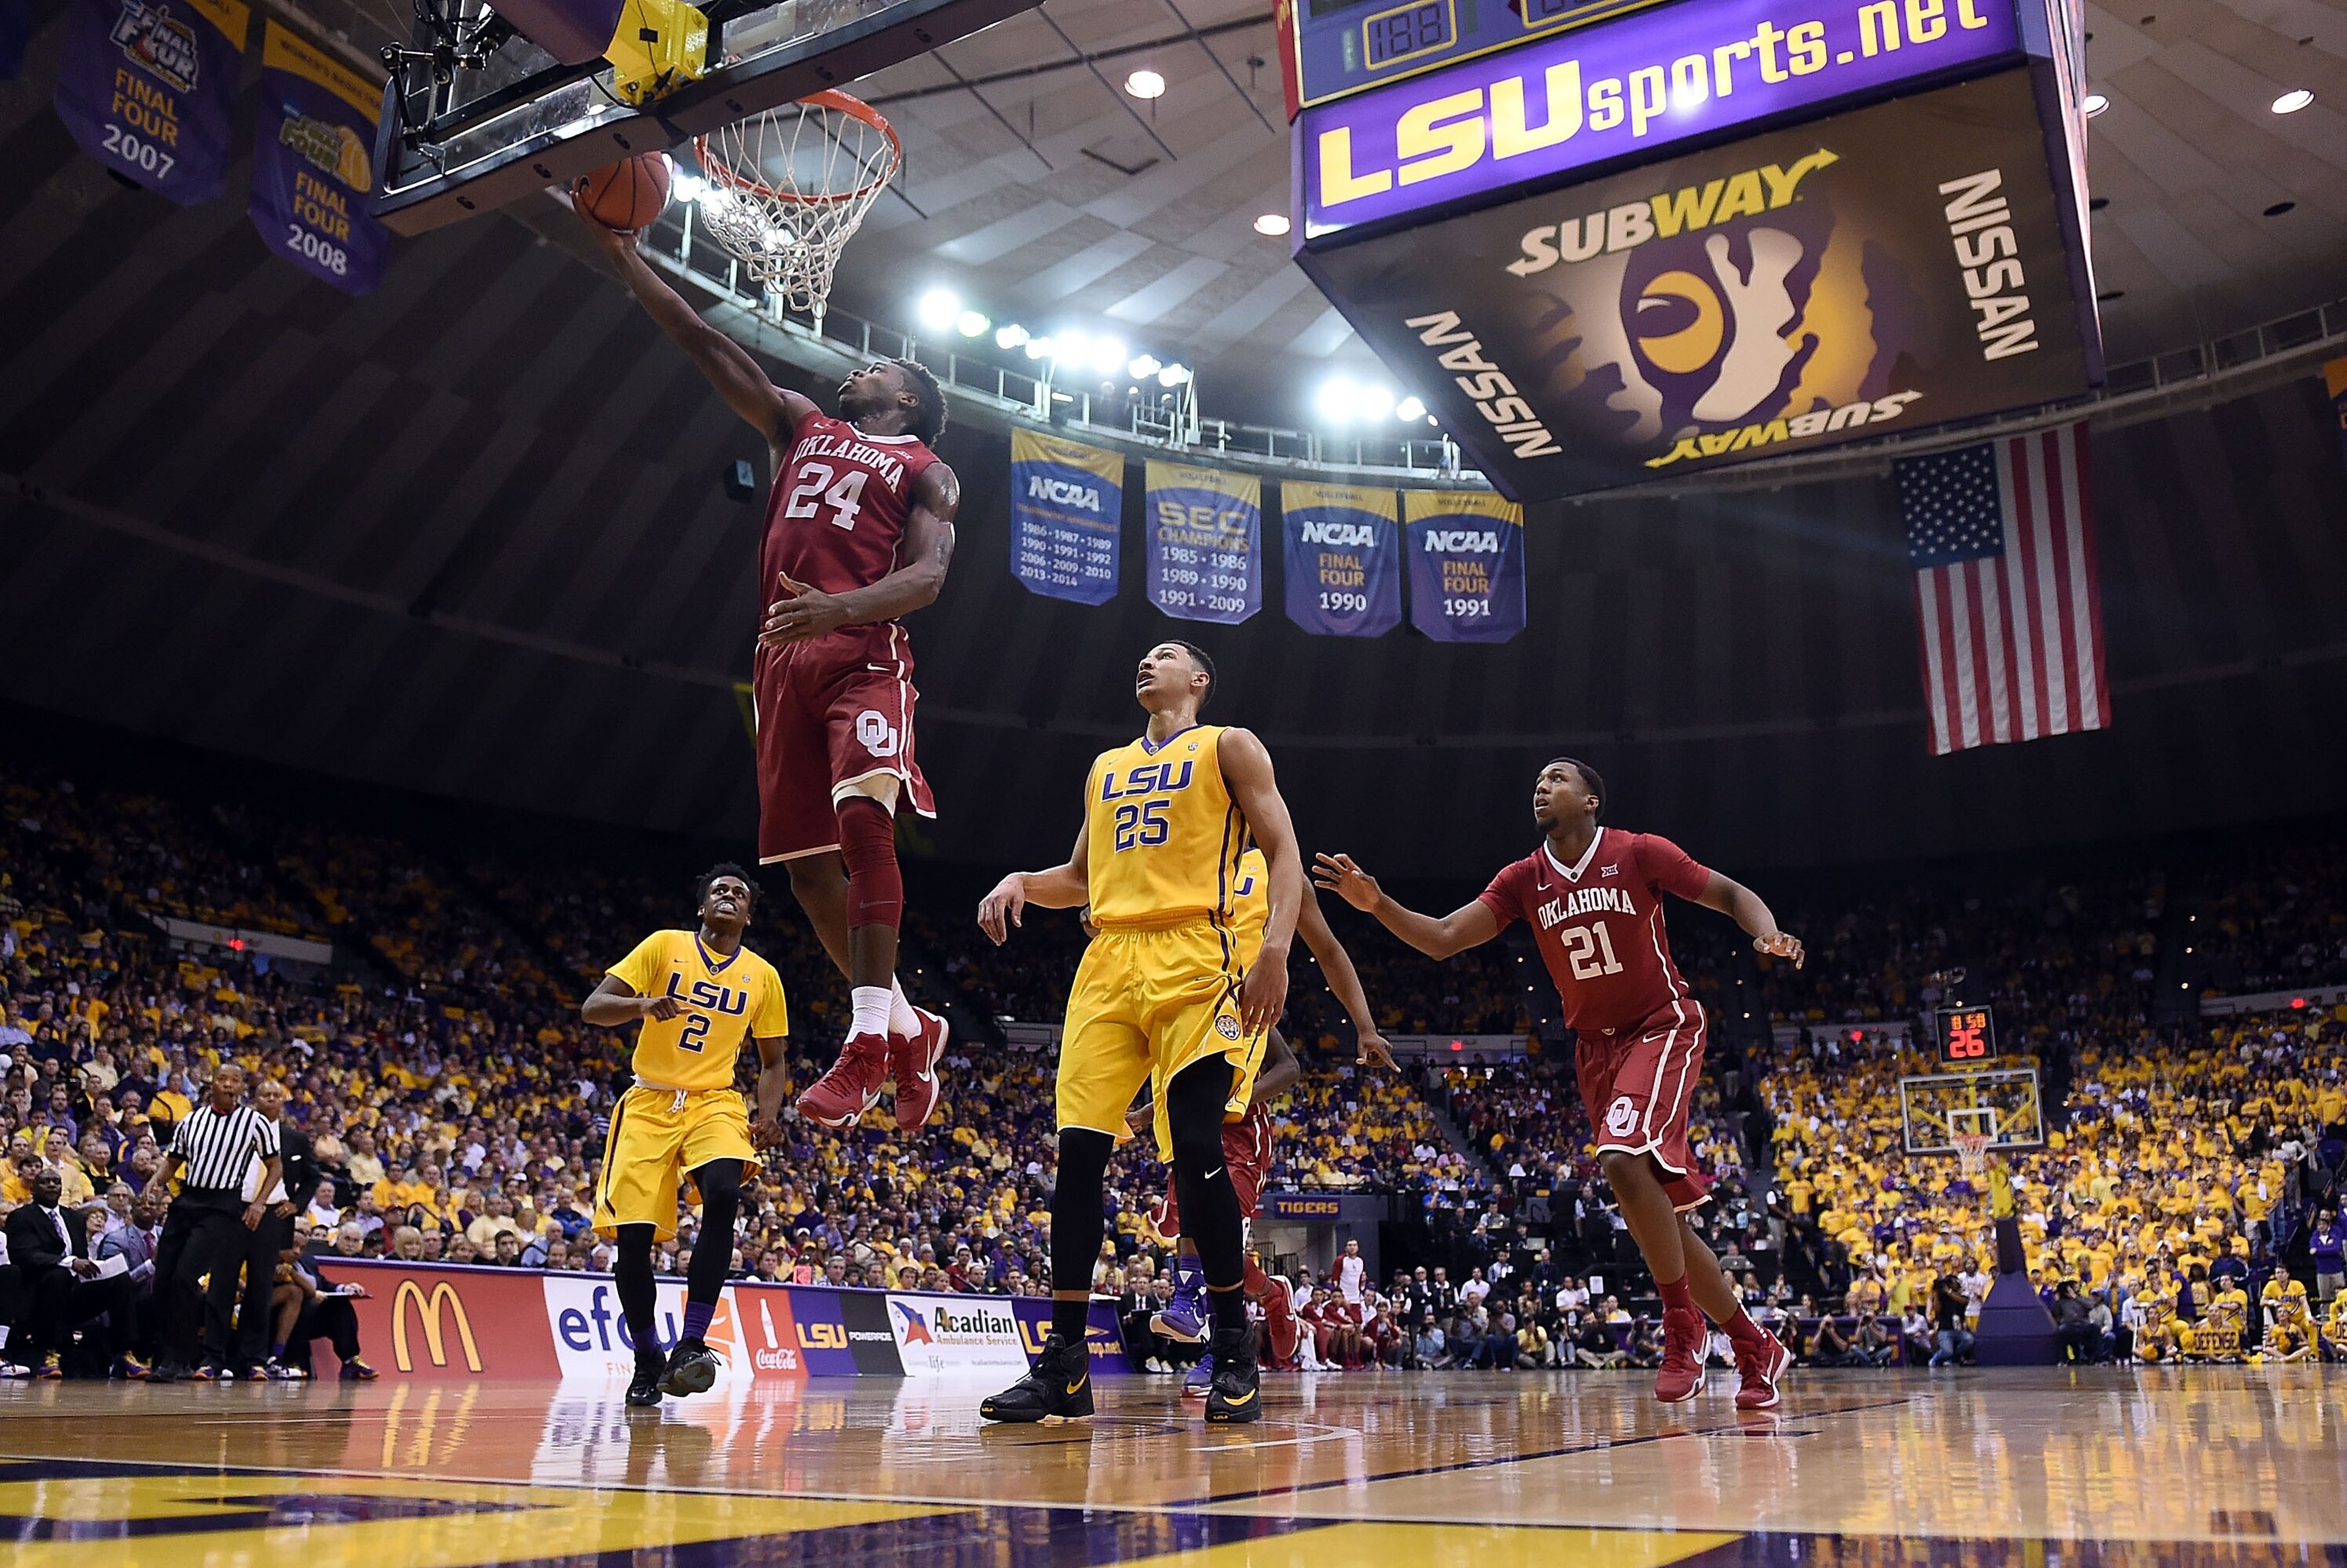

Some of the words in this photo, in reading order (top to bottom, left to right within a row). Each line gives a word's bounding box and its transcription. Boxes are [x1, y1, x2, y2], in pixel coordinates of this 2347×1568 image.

[115, 67, 179, 121] FINAL
[112, 91, 179, 147] FOUR
[101, 123, 175, 180] 2007
[296, 171, 350, 219] FINAL
[294, 194, 351, 244] FOUR
[1506, 147, 1840, 278] SUBWAY
[287, 223, 347, 275] 2008
[1938, 168, 2040, 361] NISSAN
[1404, 310, 1563, 459] NISSAN
[1644, 390, 1923, 468] SUBWAY
[792, 434, 905, 494] OKLAHOMA
[784, 462, 870, 532] 24
[1028, 475, 1099, 512] NCAA
[1158, 500, 1246, 535] SEC
[1022, 521, 1048, 537] 1986
[1054, 528, 1079, 544] 1987
[1086, 535, 1112, 550] 1989
[1157, 525, 1249, 553] CHAMPIONS
[1302, 521, 1375, 547] NCAA
[1424, 530, 1499, 553] NCAA
[1020, 551, 1046, 566] 2006
[1052, 558, 1079, 573] 2009
[1085, 565, 1112, 579] 2010
[1021, 536, 1047, 552] 1990
[1054, 543, 1078, 558] 1991
[1087, 551, 1111, 564] 1992
[1161, 546, 1197, 564] 1985
[1210, 552, 1248, 571] 1986
[1318, 553, 1364, 571] FINAL
[1019, 565, 1046, 580] 2013
[1052, 572, 1078, 586] 2014
[1161, 567, 1199, 585] 1989
[1211, 575, 1248, 592] 1990
[1320, 569, 1365, 586] FOUR
[1443, 560, 1488, 576] FINAL
[1443, 576, 1489, 593] FOUR
[1158, 588, 1196, 607] 1991
[1208, 594, 1246, 614] 2009
[1320, 592, 1368, 612] 1990
[1444, 598, 1491, 616] 1991
[856, 710, 898, 757] OU
[1101, 760, 1194, 802] LSU
[1114, 799, 1171, 853] 25
[1538, 887, 1637, 931] OKLAHOMA
[1560, 920, 1624, 980] 21
[665, 971, 748, 1015] LSU
[677, 1013, 711, 1054] 2
[1949, 1028, 1986, 1058] 26
[1606, 1096, 1640, 1138] OU
[1277, 1201, 1339, 1214] TIGERS
[934, 1306, 1015, 1334] Acadian
[795, 1323, 849, 1349] LSU
[848, 1331, 894, 1341] POWERADE
[936, 1334, 984, 1345] Ambulance
[986, 1335, 1018, 1345] Service
[2194, 1330, 2237, 1351] DEFENSE
